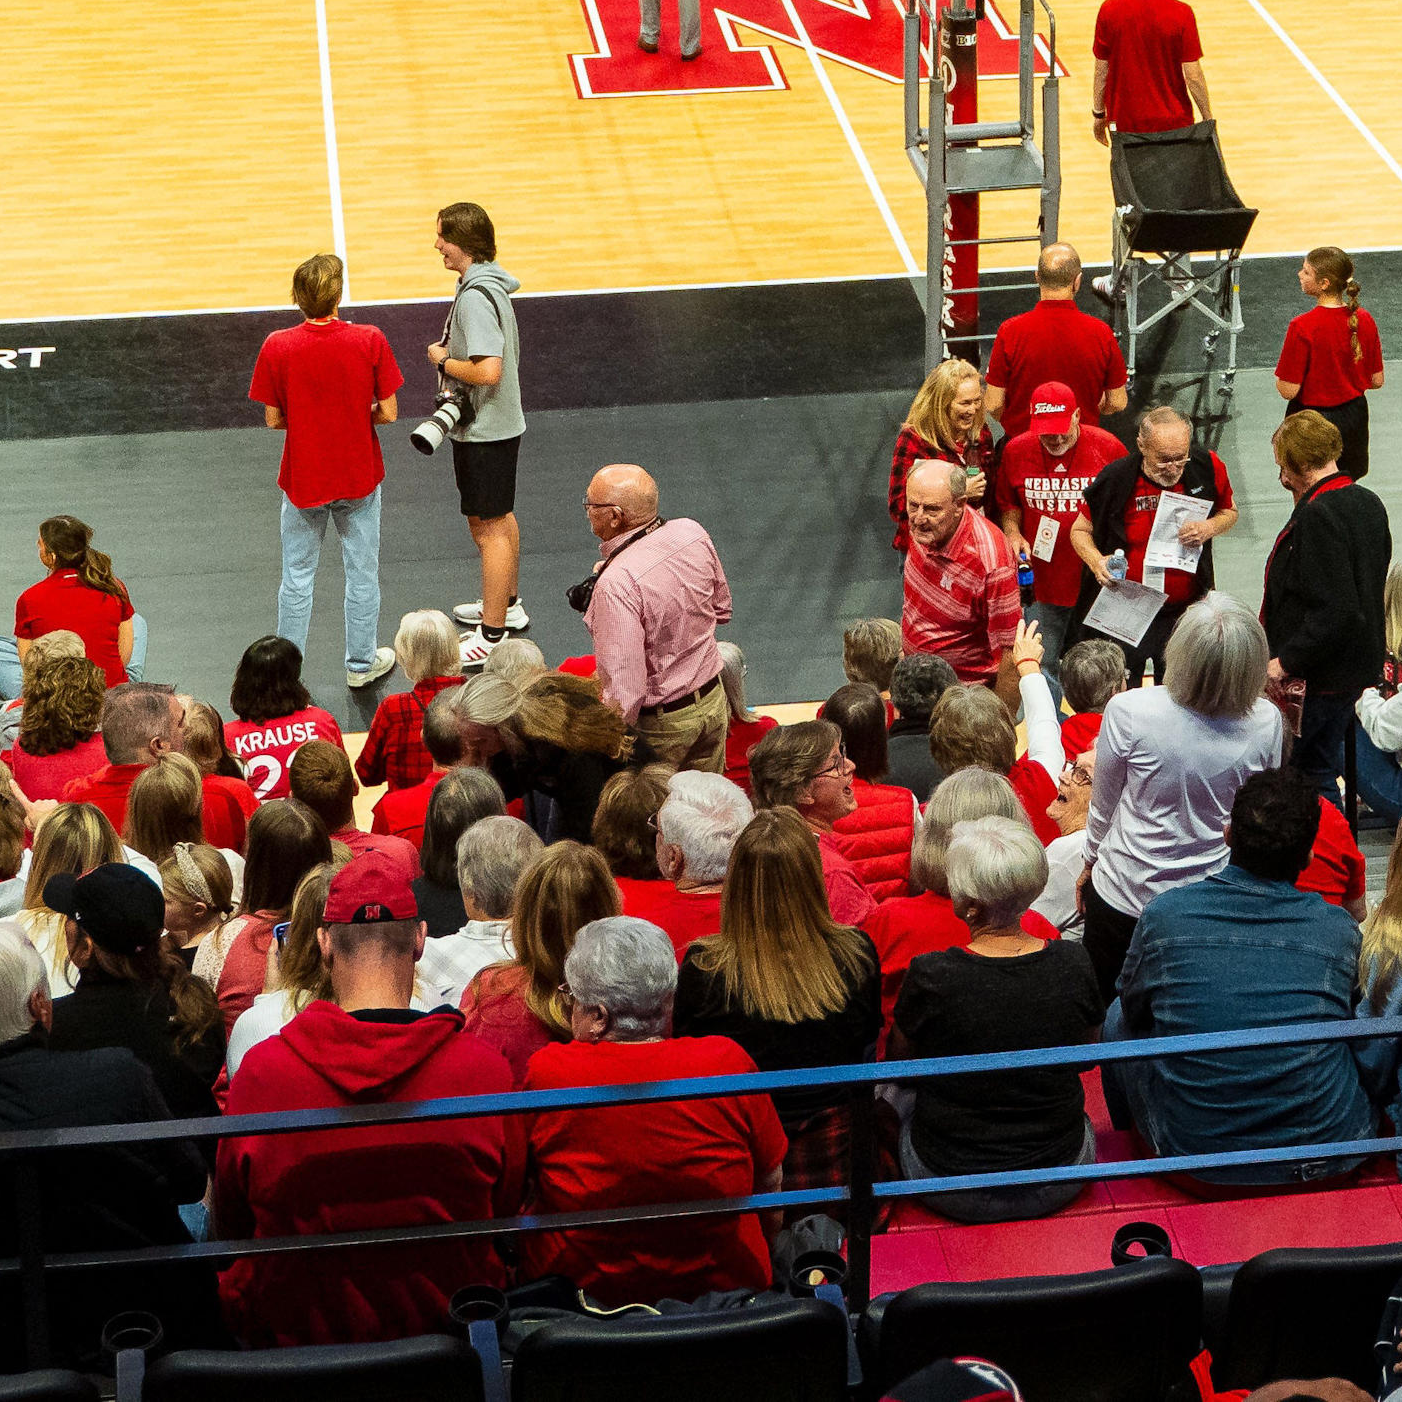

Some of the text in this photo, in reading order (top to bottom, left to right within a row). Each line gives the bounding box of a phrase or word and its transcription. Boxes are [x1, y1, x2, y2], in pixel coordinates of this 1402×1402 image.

[1034, 403, 1066, 414] Titleist
[236, 721, 319, 754] KRAUSE
[244, 754, 300, 800] 2
[365, 905, 380, 919] N
